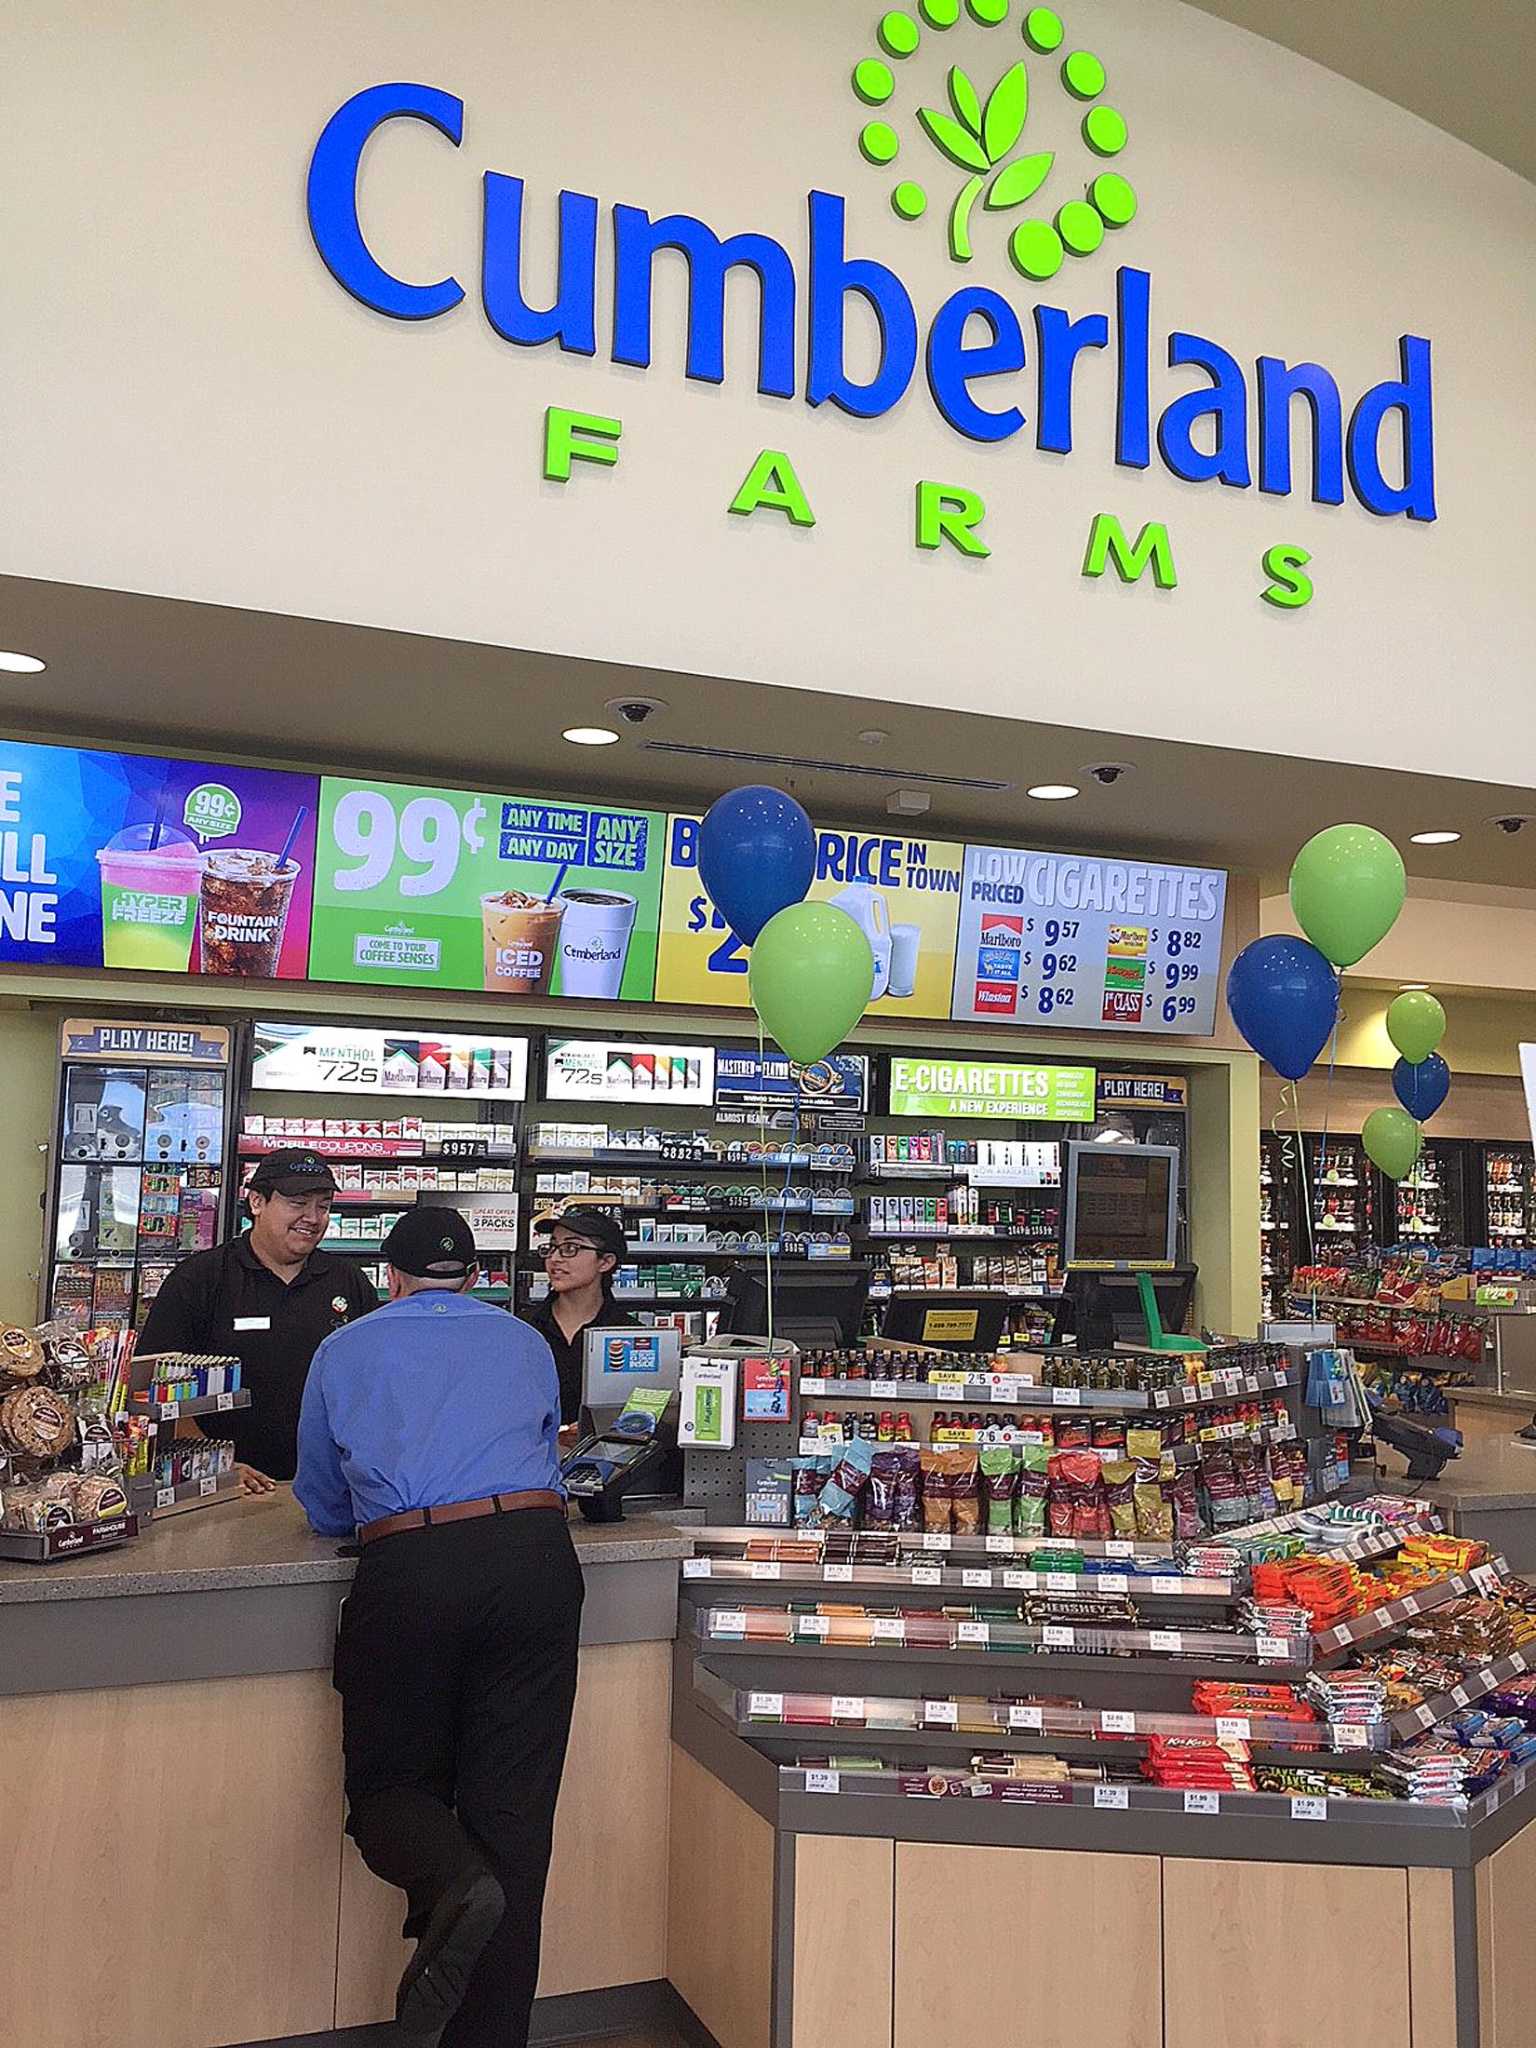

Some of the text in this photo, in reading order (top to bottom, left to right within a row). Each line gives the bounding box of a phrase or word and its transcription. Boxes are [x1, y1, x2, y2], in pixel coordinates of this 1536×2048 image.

[307, 82, 1438, 523] Cumberland
[543, 406, 1314, 608] FARMS
[507, 808, 582, 833] ANY TIME
[596, 815, 642, 843] ANY
[333, 790, 488, 897] 99¢
[507, 837, 579, 861] ANY DAY
[907, 841, 927, 866] IN
[594, 841, 638, 867] SIZE
[815, 832, 903, 887] RICE
[971, 851, 1027, 884] LOW
[906, 867, 960, 893] TOWN
[1028, 857, 1220, 922] CIGARETTES
[971, 881, 1025, 905] PRICED
[111, 906, 187, 926] FREEZE
[207, 911, 279, 928] FOUNTAIN
[214, 924, 272, 943] DRINK
[980, 931, 1022, 948] Marlboro
[369, 939, 427, 952] COME TO YOUR
[360, 948, 435, 965] COFFEE SENSES
[495, 947, 544, 967] ICED
[495, 966, 542, 979] COFFEE
[977, 990, 1012, 1004] Winston
[1113, 993, 1140, 1012] CLASS
[99, 1028, 195, 1052] PLAY HERE!
[319, 1046, 377, 1062] MENTHOL
[317, 1060, 379, 1084] 72s
[717, 1058, 755, 1074] MASTERED
[560, 1068, 603, 1085] 72s
[895, 1063, 1049, 1098] E-CIGARETTES
[1103, 1080, 1165, 1098] PLAY HERE!
[715, 1112, 746, 1123] ALMOST
[948, 1100, 1049, 1116] A NEW EXPERIENCE
[481, 1218, 515, 1228] PACKS
[1041, 1602, 1120, 1615] HERSHEY'S
[1282, 1774, 1326, 1787] TAKE 5
